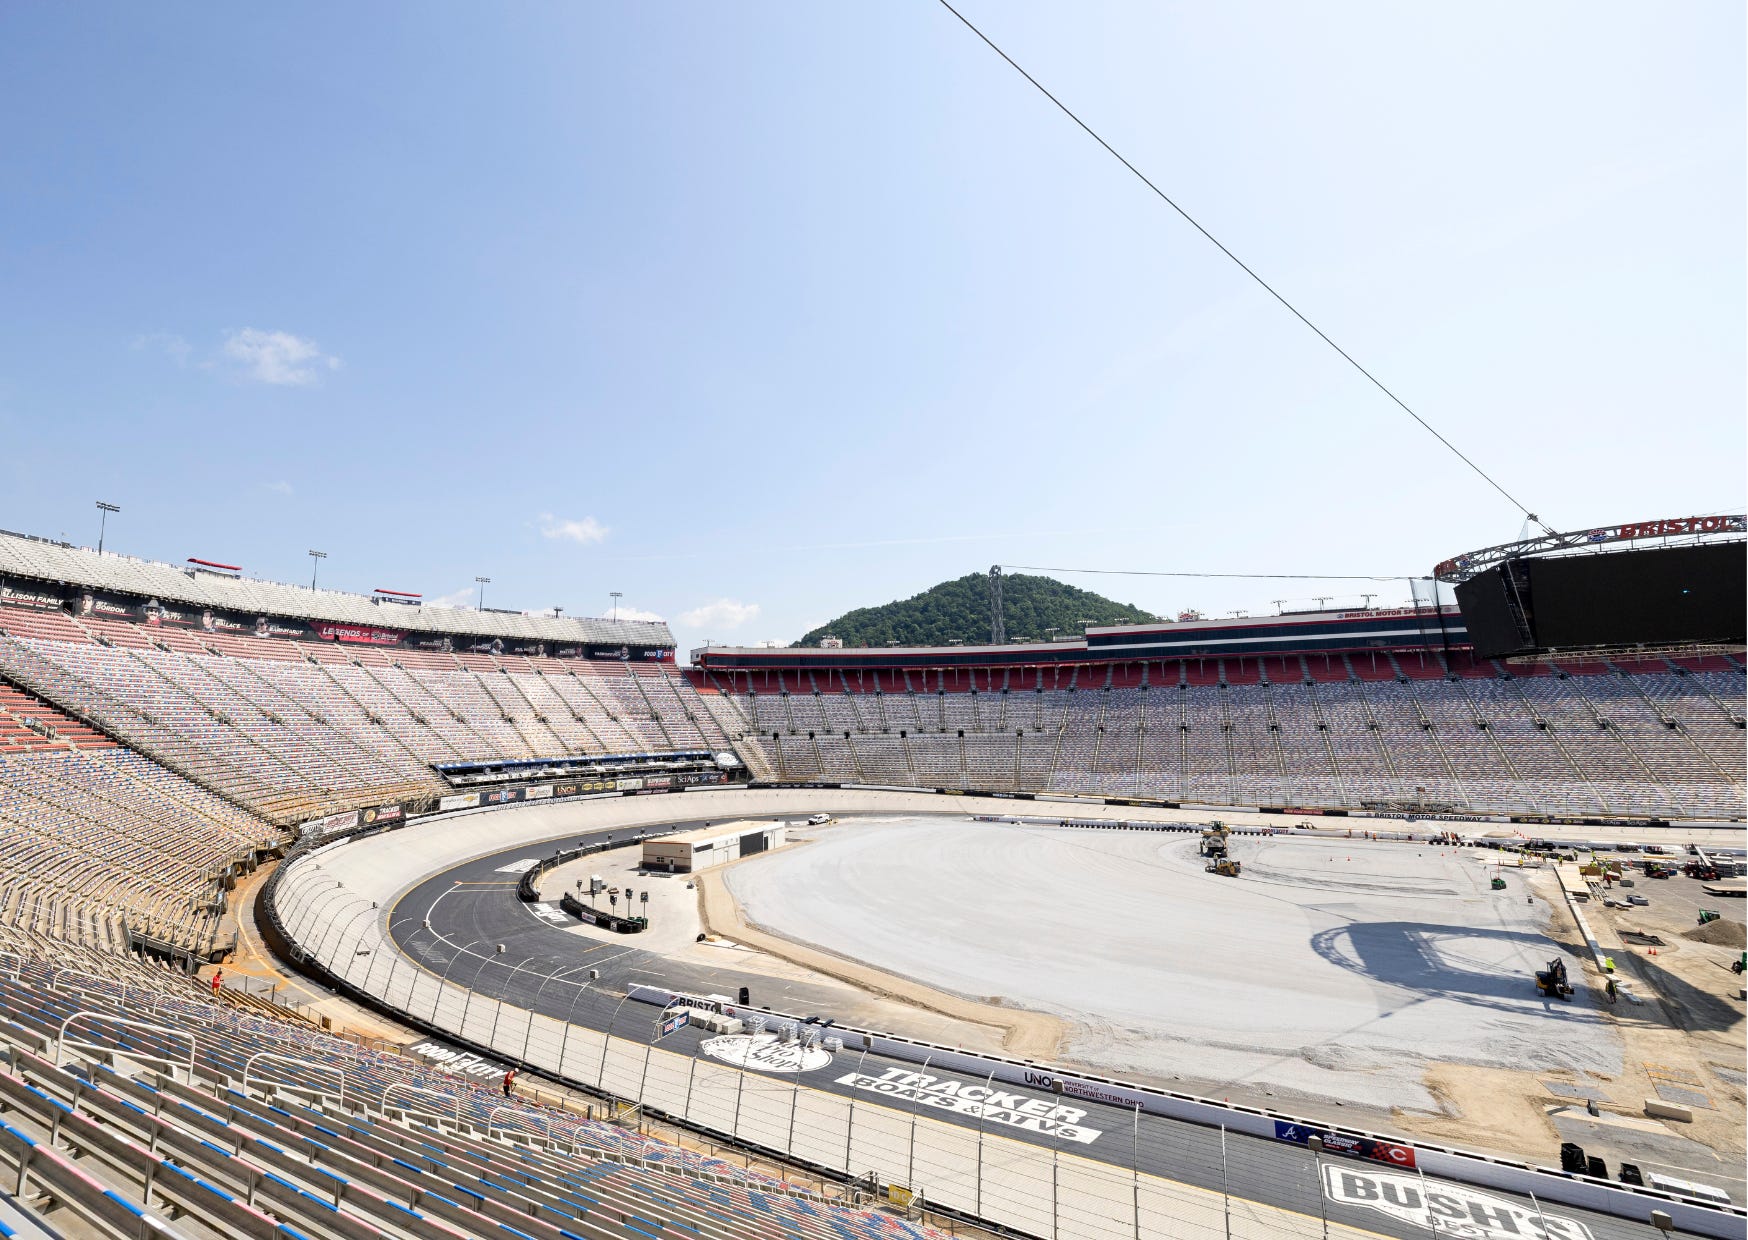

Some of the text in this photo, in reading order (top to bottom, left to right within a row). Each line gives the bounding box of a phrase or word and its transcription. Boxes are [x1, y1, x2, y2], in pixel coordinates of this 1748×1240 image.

[1619, 515, 1734, 539] BRISTOL
[1, 591, 36, 602] ALLISON
[37, 596, 64, 606] FAMILY
[95, 604, 126, 614] GORDON
[163, 612, 182, 620] PETTY
[322, 627, 361, 637] LEGENDS
[678, 775, 699, 784] SciAps
[679, 997, 716, 1012] BRISTO
[409, 1042, 457, 1061] FOOD
[466, 1062, 509, 1080] CITY
[752, 1052, 803, 1069] Shops
[1024, 1071, 1054, 1088] UNO
[1063, 1080, 1093, 1090] UNIVERSITY
[853, 1075, 958, 1108] BOATS
[963, 1104, 980, 1115] &
[877, 1067, 1087, 1125] TRACKER
[1065, 1086, 1144, 1108] NORTHWESTERN OHIO
[1323, 1134, 1360, 1145] SPEEDWAY
[1323, 1139, 1352, 1149] CLASSIC
[1341, 1172, 1575, 1240] BUSH'S
[1426, 1214, 1494, 1238] BEST
